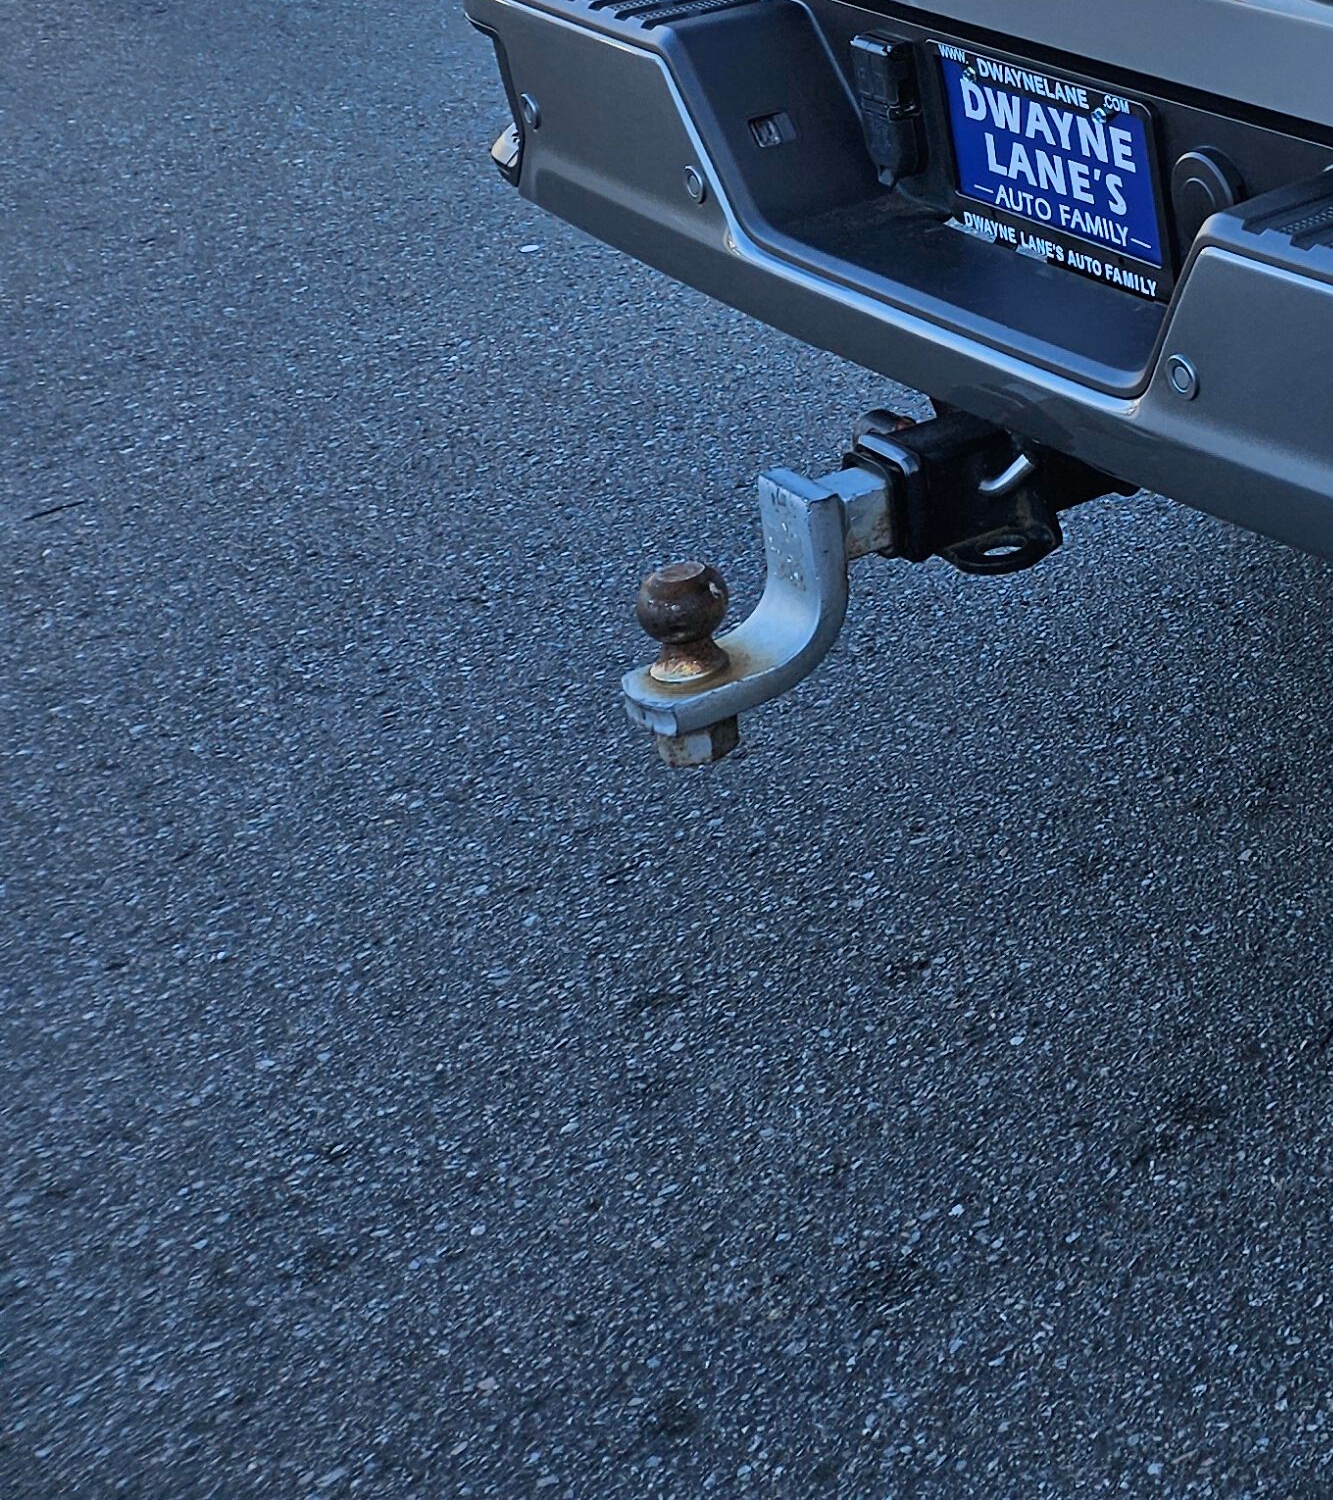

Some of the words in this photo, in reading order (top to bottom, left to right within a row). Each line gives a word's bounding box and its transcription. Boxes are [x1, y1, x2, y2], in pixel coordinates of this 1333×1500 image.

[961, 79, 1136, 173] DWAYNE
[985, 133, 1128, 216] LANE'S
[995, 184, 1052, 221] AUTO
[1059, 204, 1129, 247] FAMILY
[963, 211, 1017, 244] DWAYNE
[1020, 232, 1065, 262] LANE'S
[1068, 249, 1103, 276] AUTO
[1105, 265, 1158, 297] FAMILY
